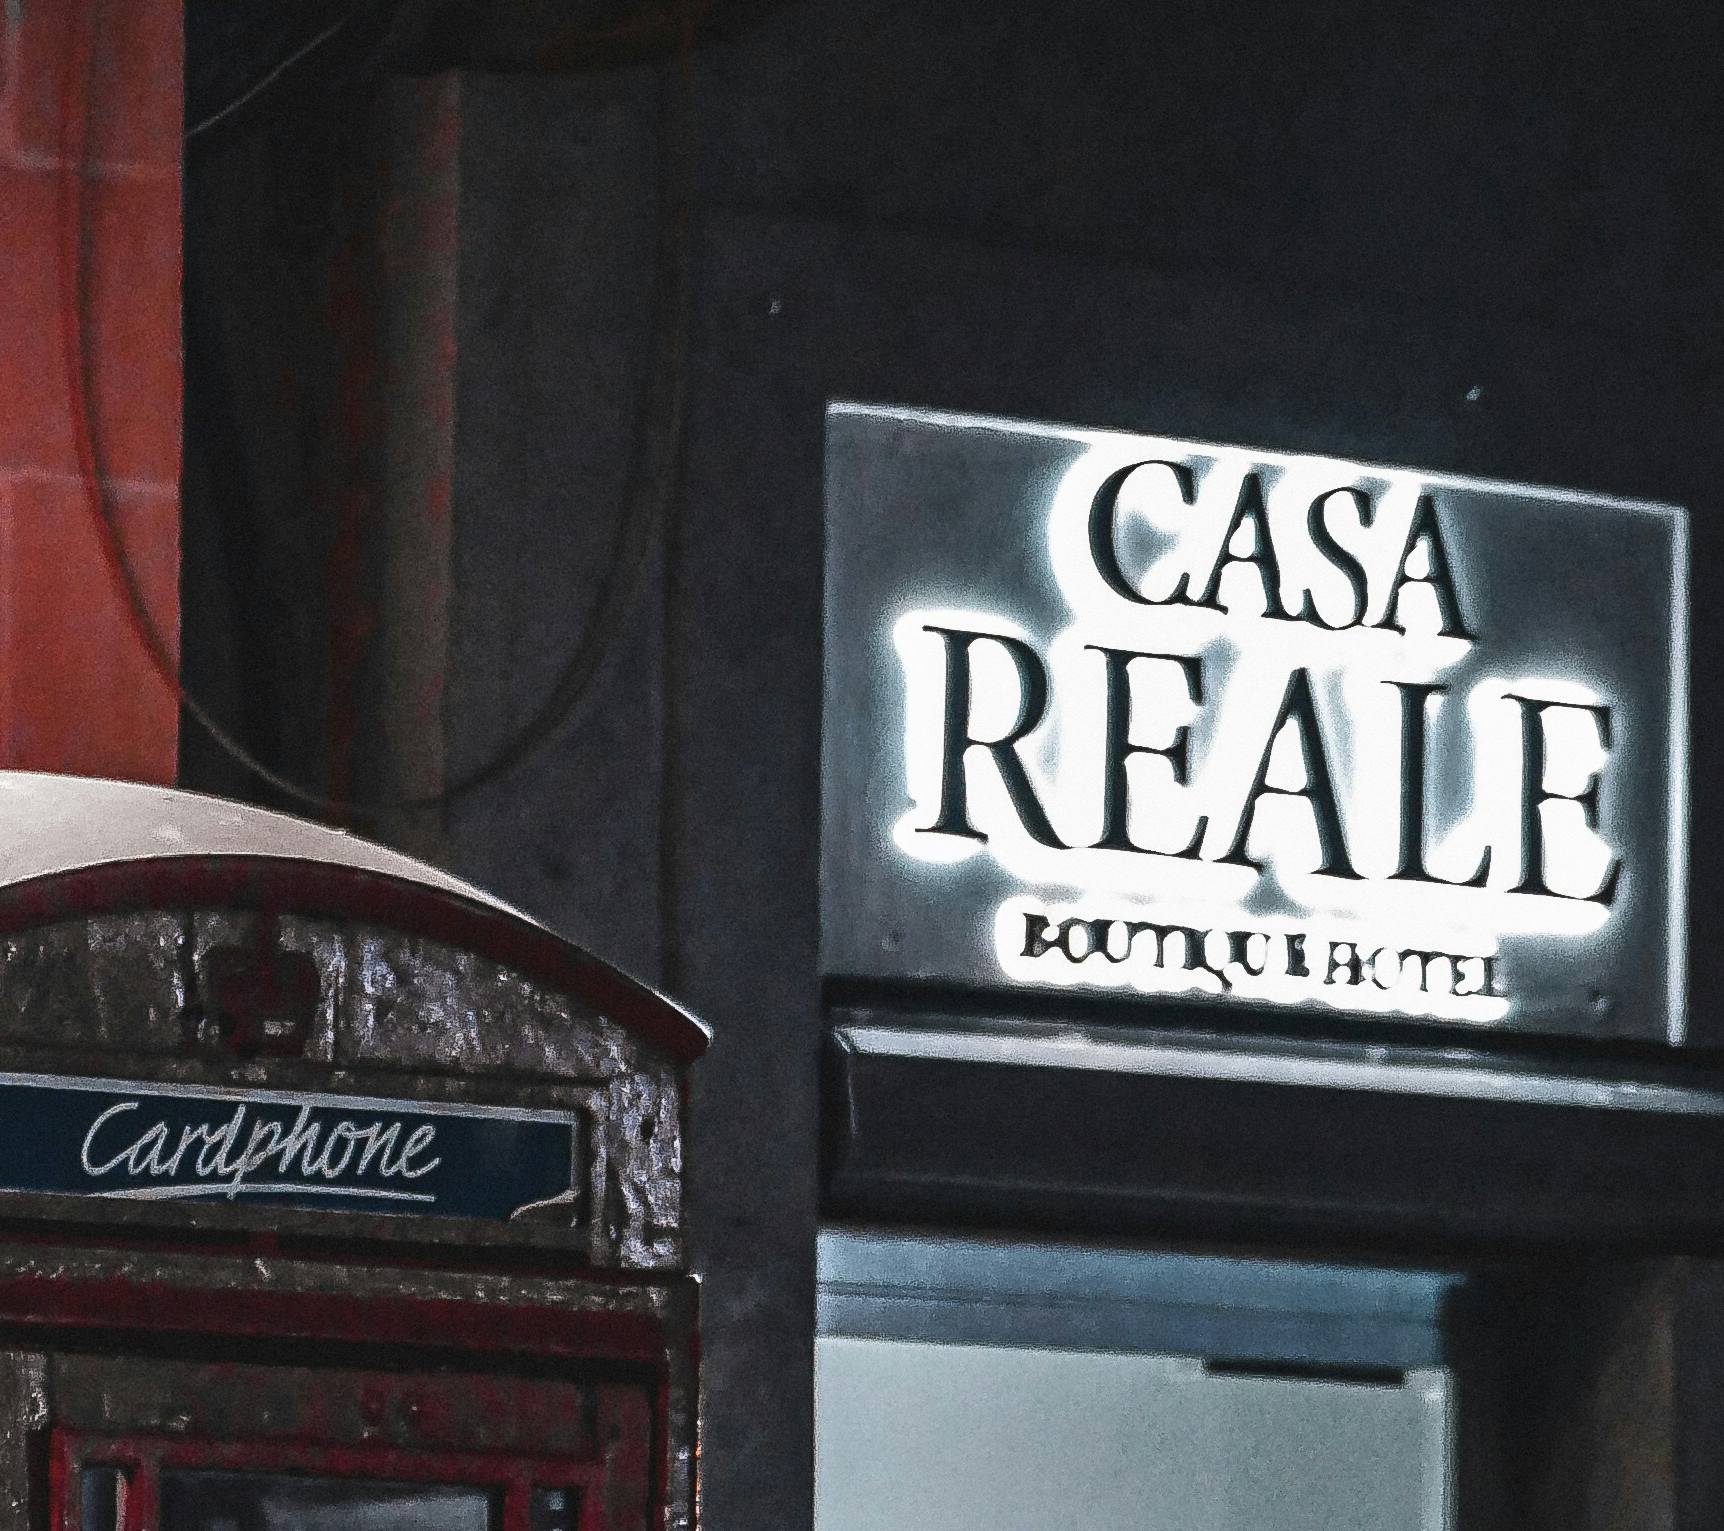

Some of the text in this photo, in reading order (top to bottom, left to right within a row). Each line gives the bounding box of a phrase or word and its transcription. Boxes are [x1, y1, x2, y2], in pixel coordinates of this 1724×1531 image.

[1087, 458, 1476, 641] CASA
[914, 623, 1623, 906] REALE
[1020, 911, 1503, 998] BOUTIQUE HOTEL
[81, 1101, 441, 1199] Cardphone
